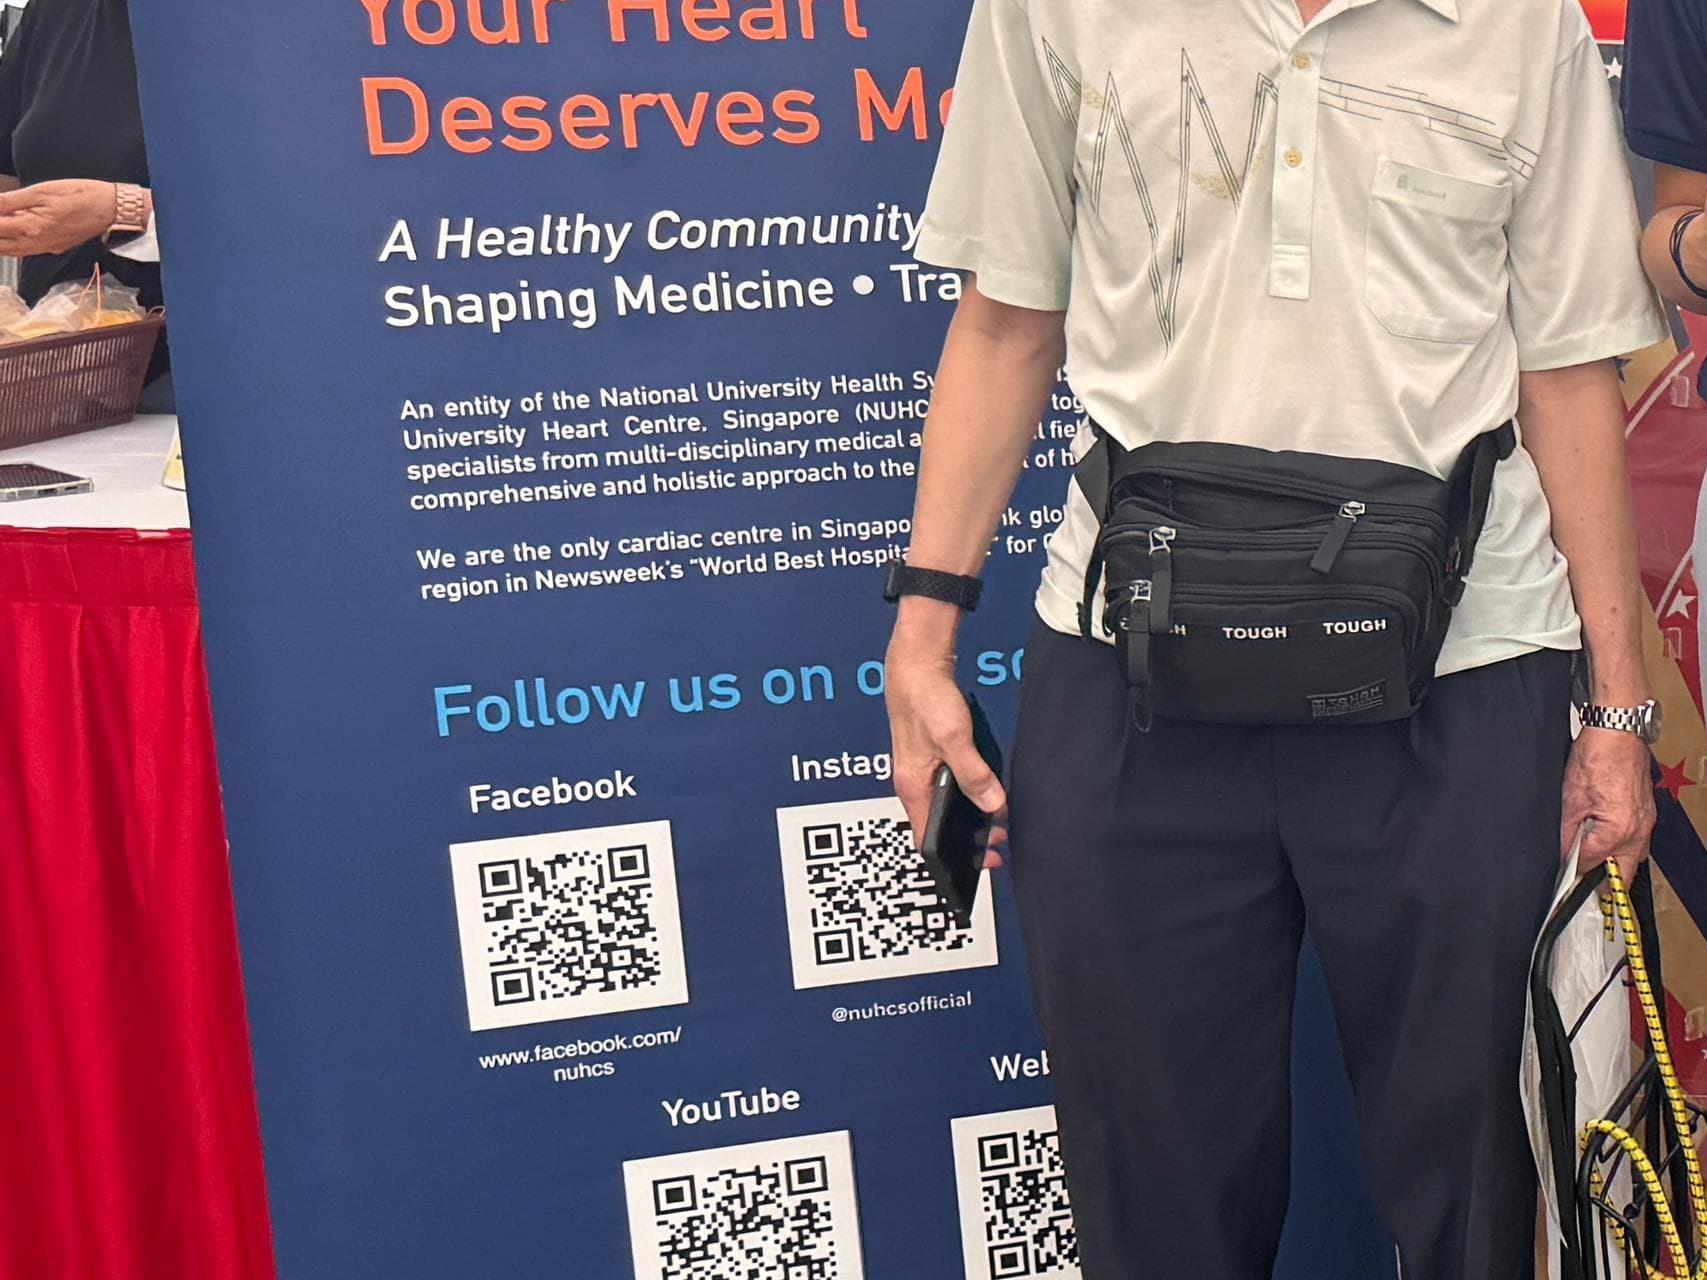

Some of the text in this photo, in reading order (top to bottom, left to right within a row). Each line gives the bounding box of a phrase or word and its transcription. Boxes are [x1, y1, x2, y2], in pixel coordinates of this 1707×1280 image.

[361, 66, 954, 156] Deserves M
[378, 203, 926, 264] A Healthy Community
[385, 282, 598, 333] Shaping
[613, 271, 834, 317] Medicine
[400, 399, 435, 421] An
[444, 394, 511, 419] entity
[520, 392, 544, 413] of
[552, 390, 591, 411] the
[600, 383, 699, 409] National
[707, 376, 822, 402] University
[831, 372, 904, 395] Health
[403, 425, 527, 451] University
[543, 418, 609, 442] Heart
[723, 408, 840, 433] Singapore
[407, 456, 537, 483] specialists
[543, 452, 600, 473] from
[605, 434, 809, 467] multi-disciplinary
[816, 430, 904, 453] medical
[410, 480, 598, 512] comprehensive
[603, 474, 648, 496] and
[653, 469, 736, 493] holistic
[742, 462, 848, 490] approach
[853, 459, 875, 479] to
[880, 458, 915, 477] the
[1034, 448, 1057, 468] of
[416, 548, 456, 570] We
[464, 547, 505, 566] are
[513, 541, 552, 563] the
[560, 536, 610, 561] only
[617, 530, 703, 555] cardiac
[710, 522, 784, 548] centre
[791, 521, 813, 542] in
[420, 574, 499, 602] region
[506, 572, 528, 593] in
[535, 560, 684, 591] Newsweek's
[774, 549, 825, 572] Best
[1006, 535, 1037, 554] for
[1222, 618, 1388, 640] TOUGH TOUGH
[434, 677, 646, 738] Follow
[669, 672, 740, 713] us
[762, 663, 835, 705] on
[469, 770, 637, 814] Facebook
[831, 992, 972, 1023] @nuhcsofficial
[478, 1026, 682, 1071] www.facebook.com/
[553, 1059, 615, 1084] nuhcs
[661, 1087, 801, 1128] YouTube
